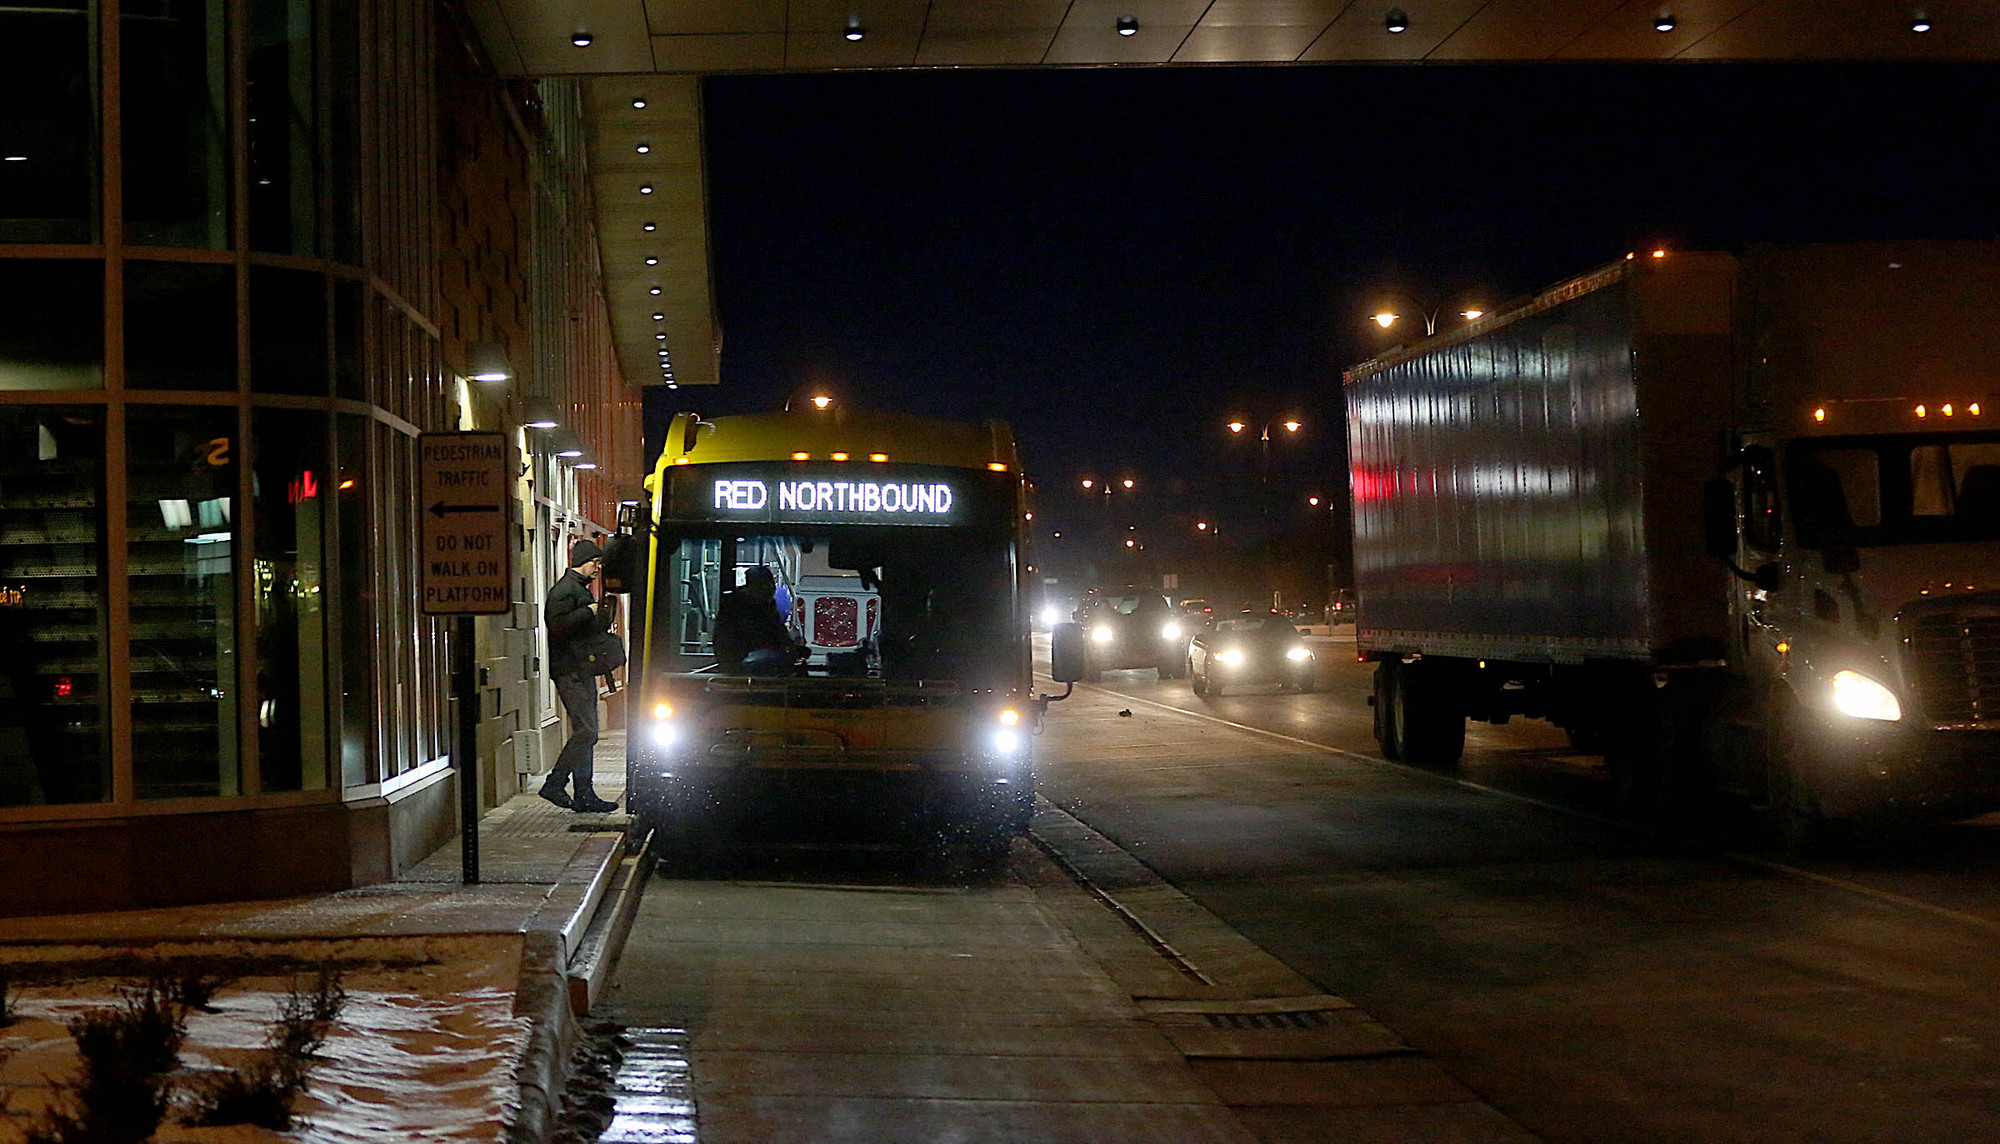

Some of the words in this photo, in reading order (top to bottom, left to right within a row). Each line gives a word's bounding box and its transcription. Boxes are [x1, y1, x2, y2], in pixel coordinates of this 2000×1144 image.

[424, 445, 502, 461] PEDESTRIAN
[437, 471, 489, 487] TRAFFIC
[714, 480, 768, 510] RED
[779, 481, 953, 514] NORTHBOUND
[436, 535, 457, 551] DO
[464, 534, 493, 550] NOT
[431, 561, 470, 577] WALK
[477, 561, 498, 576] ON
[427, 586, 504, 602] PLATFORM
